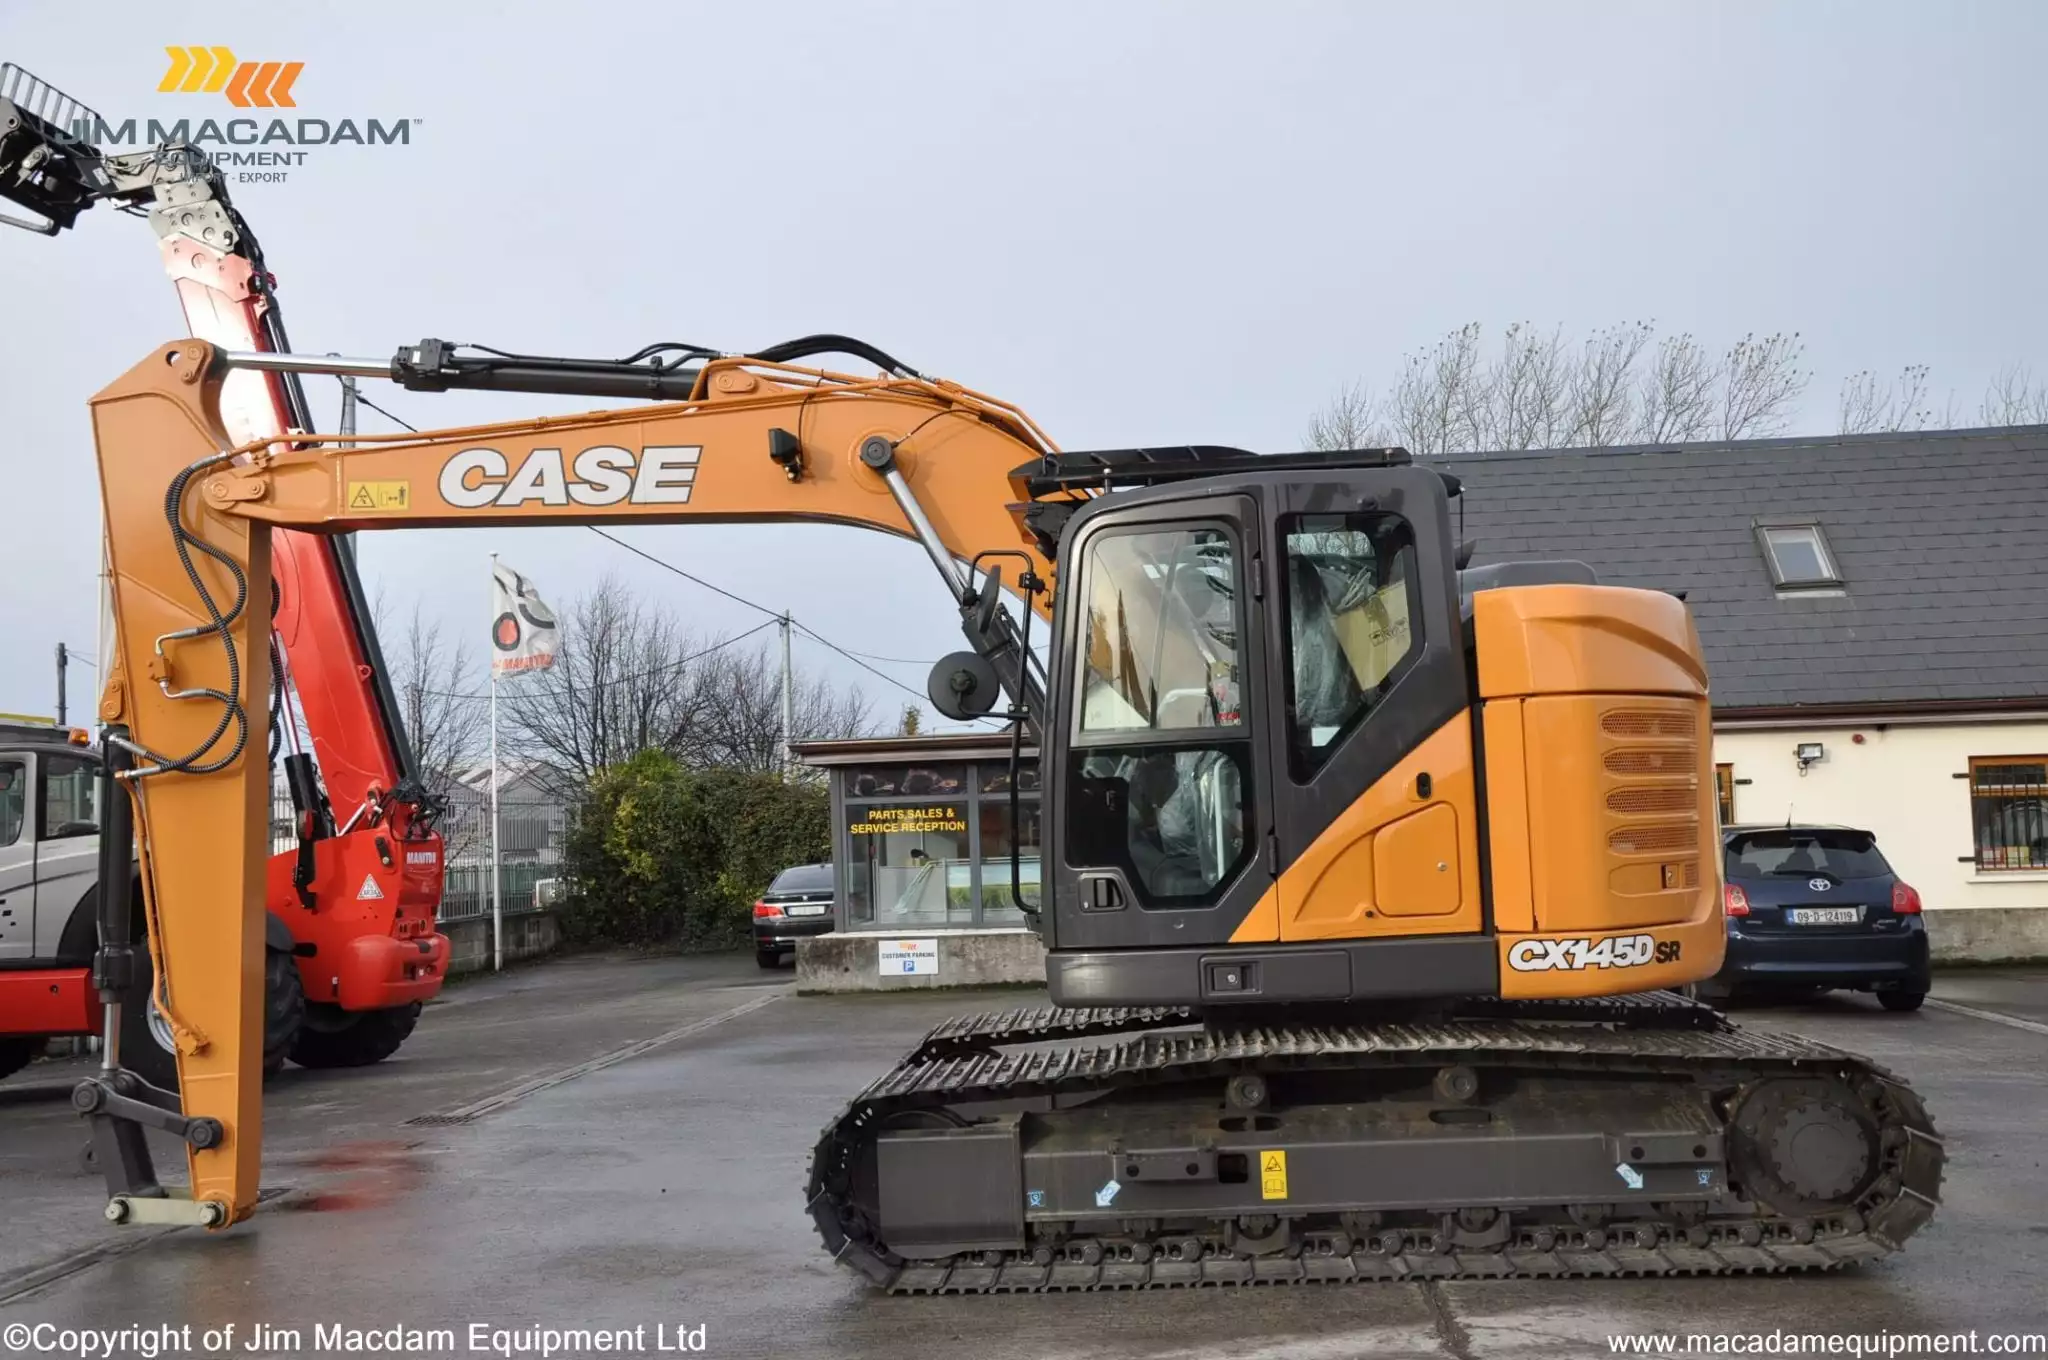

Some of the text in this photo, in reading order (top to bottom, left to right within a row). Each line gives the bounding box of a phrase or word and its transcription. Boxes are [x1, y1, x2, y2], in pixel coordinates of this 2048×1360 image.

[437, 445, 704, 509] CASE
[850, 821, 966, 834] SERVICE RECEPTION
[1507, 933, 1681, 972] CX145D SR
